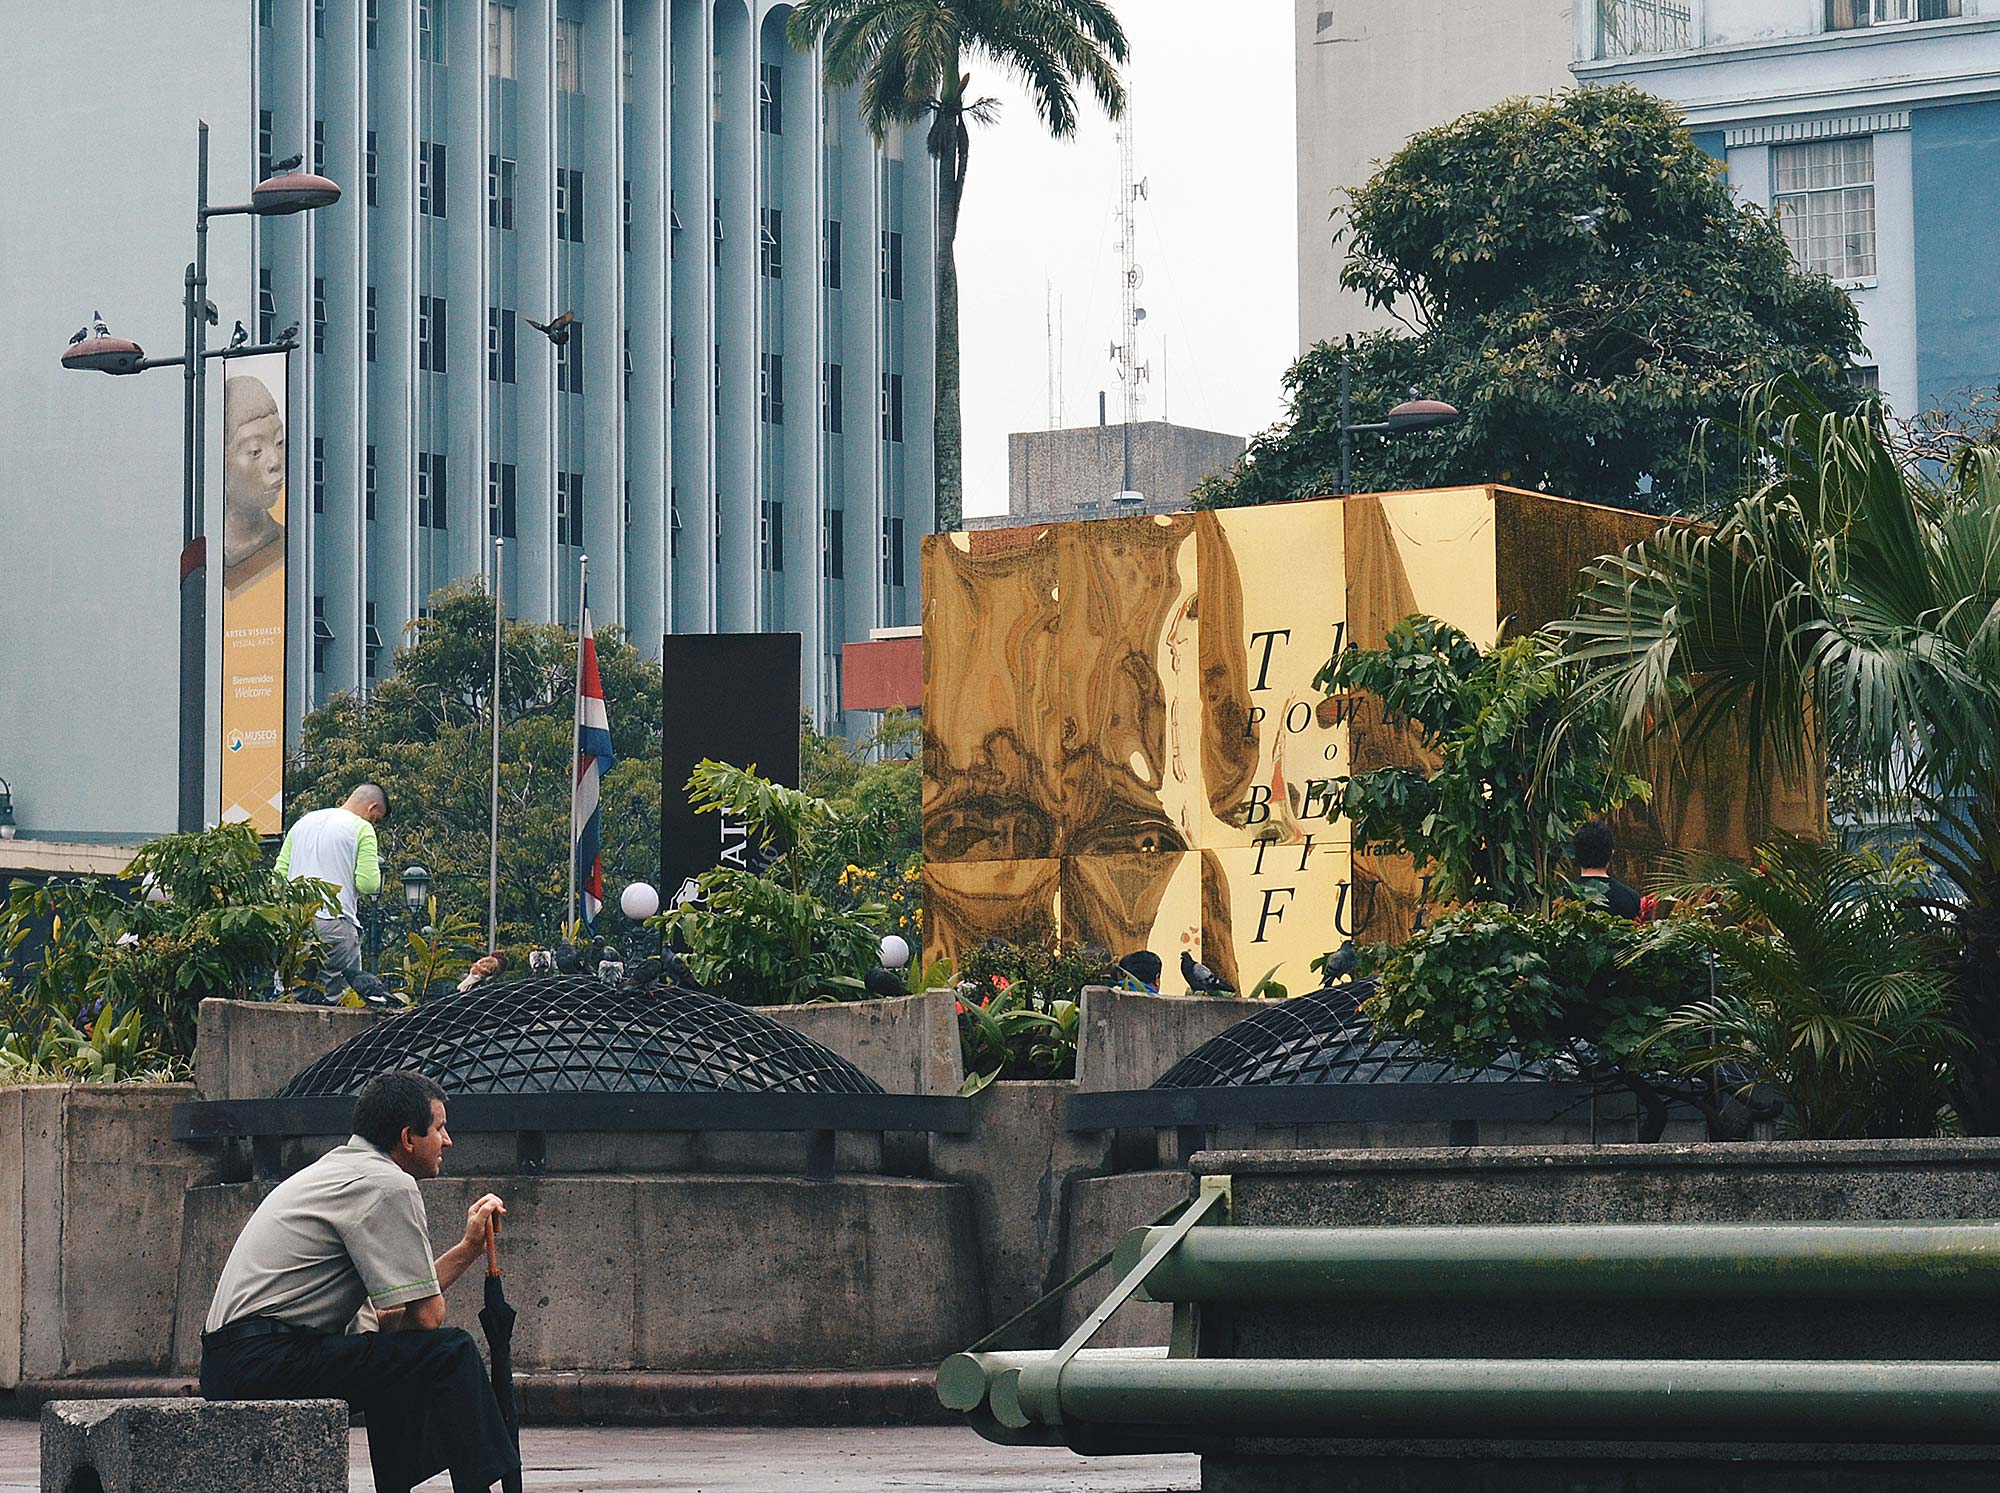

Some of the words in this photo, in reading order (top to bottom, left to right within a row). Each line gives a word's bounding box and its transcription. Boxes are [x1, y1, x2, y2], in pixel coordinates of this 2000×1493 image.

[224, 629, 247, 638] ARTES
[248, 626, 282, 636] VISUALES
[232, 639, 256, 649] VISUAL
[258, 637, 275, 647] ARTS
[232, 674, 274, 685] Bienvenidos
[234, 687, 273, 698] Welcome
[244, 729, 278, 741] MUSEOS
